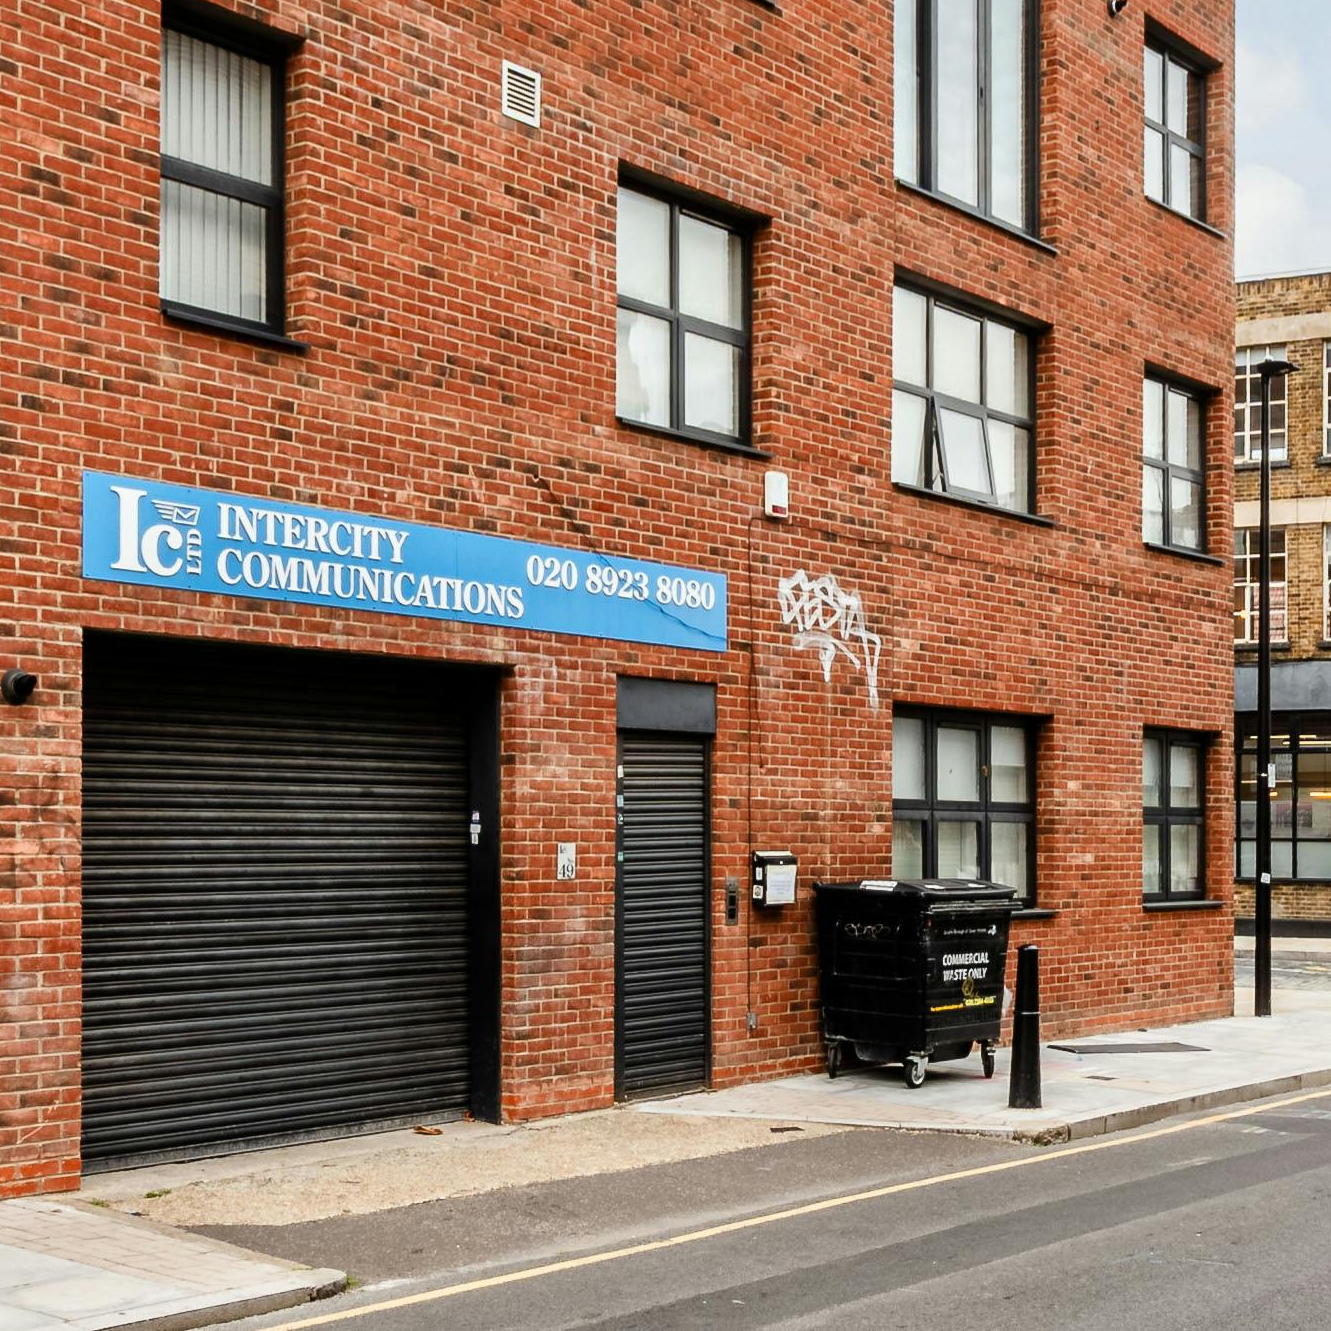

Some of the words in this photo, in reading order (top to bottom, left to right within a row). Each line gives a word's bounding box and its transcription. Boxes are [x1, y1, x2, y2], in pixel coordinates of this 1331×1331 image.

[186, 528, 202, 576] LTD
[216, 502, 410, 563] INTERCITY
[217, 547, 525, 619] COMMUNICATIONS
[525, 554, 579, 590] 020
[584, 564, 650, 601] 8923
[655, 574, 716, 610] 8080
[558, 863, 575, 879] 49
[942, 952, 990, 966] COMMERCIAL
[943, 968, 968, 981] WASTE
[968, 967, 988, 980] ONLY
